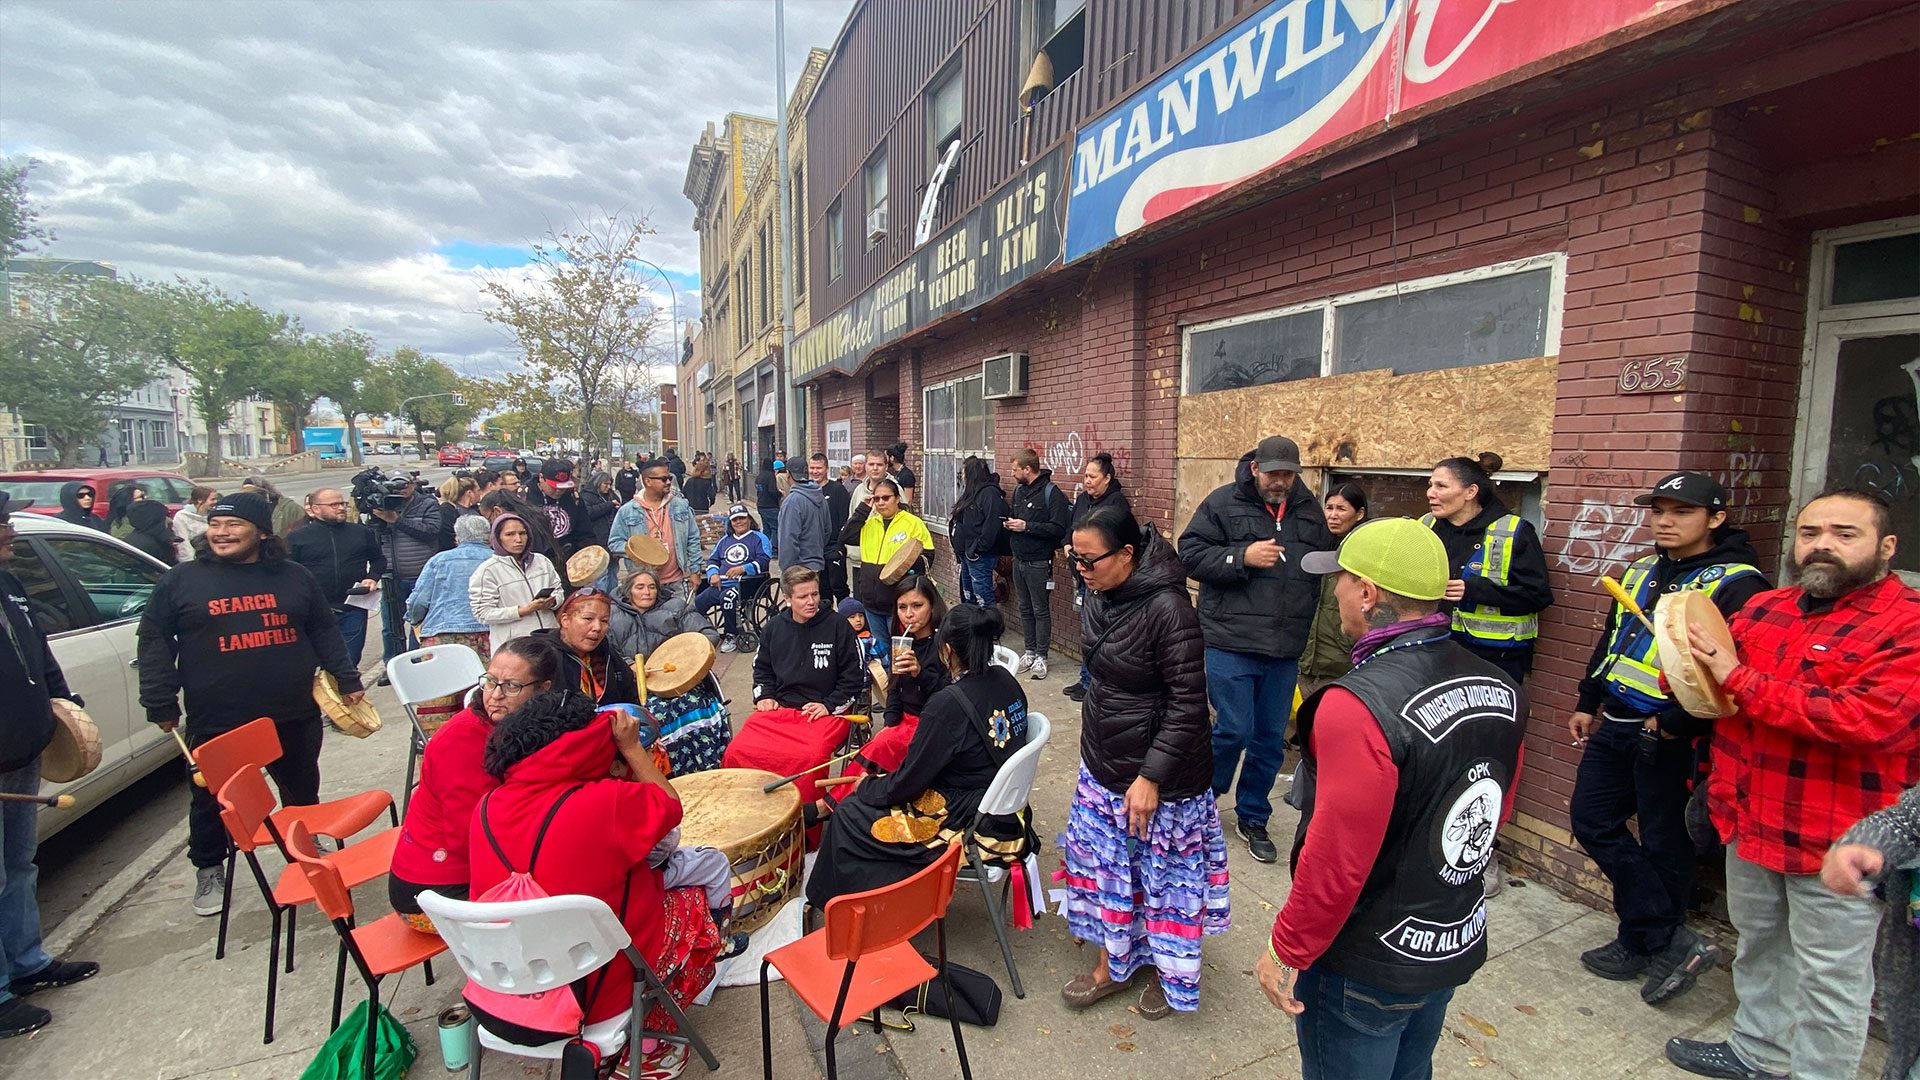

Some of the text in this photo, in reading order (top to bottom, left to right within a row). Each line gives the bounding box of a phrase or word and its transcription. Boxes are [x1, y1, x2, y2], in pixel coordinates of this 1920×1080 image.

[1073, 0, 1386, 197] MANWIN
[996, 171, 1046, 238] VLT'S
[937, 228, 967, 275] BEER
[1000, 221, 1038, 276] ATM
[876, 262, 917, 312] BEVERAGE
[928, 258, 976, 311] VENDOR
[839, 301, 875, 355] Hotel
[883, 298, 907, 334] ROOM
[1618, 357, 1687, 391] 653
[208, 594, 277, 616] SEARCH
[261, 612, 288, 627] The
[218, 628, 297, 652] LANDFILLS
[1415, 685, 1512, 731] INDIGENOUS MOVEMENT
[1468, 762, 1491, 782] OPK
[1399, 926, 1436, 952] FOR
[1436, 929, 1460, 952] ALL
